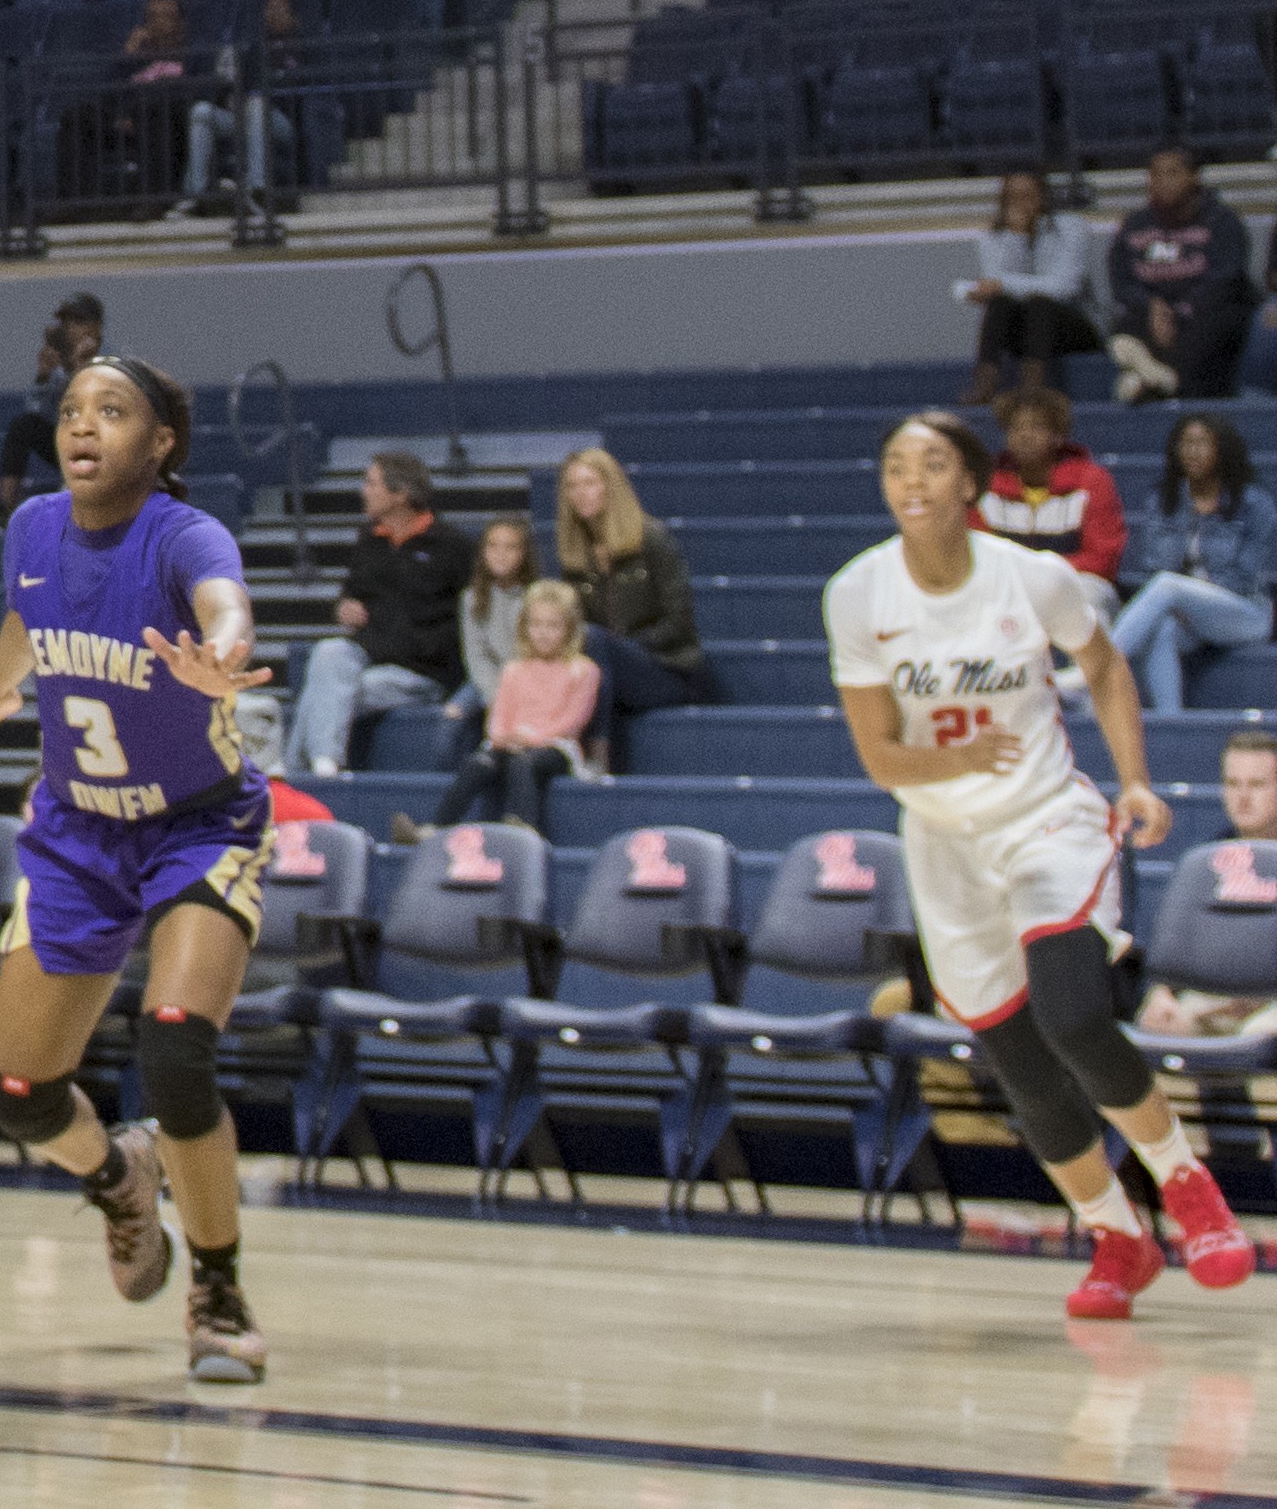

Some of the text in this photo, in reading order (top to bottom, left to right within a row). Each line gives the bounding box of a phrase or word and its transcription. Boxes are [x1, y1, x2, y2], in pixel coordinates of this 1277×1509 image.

[28, 627, 156, 690] EMOYNE
[893, 657, 1028, 697] Ole Miss
[63, 695, 129, 778] 3
